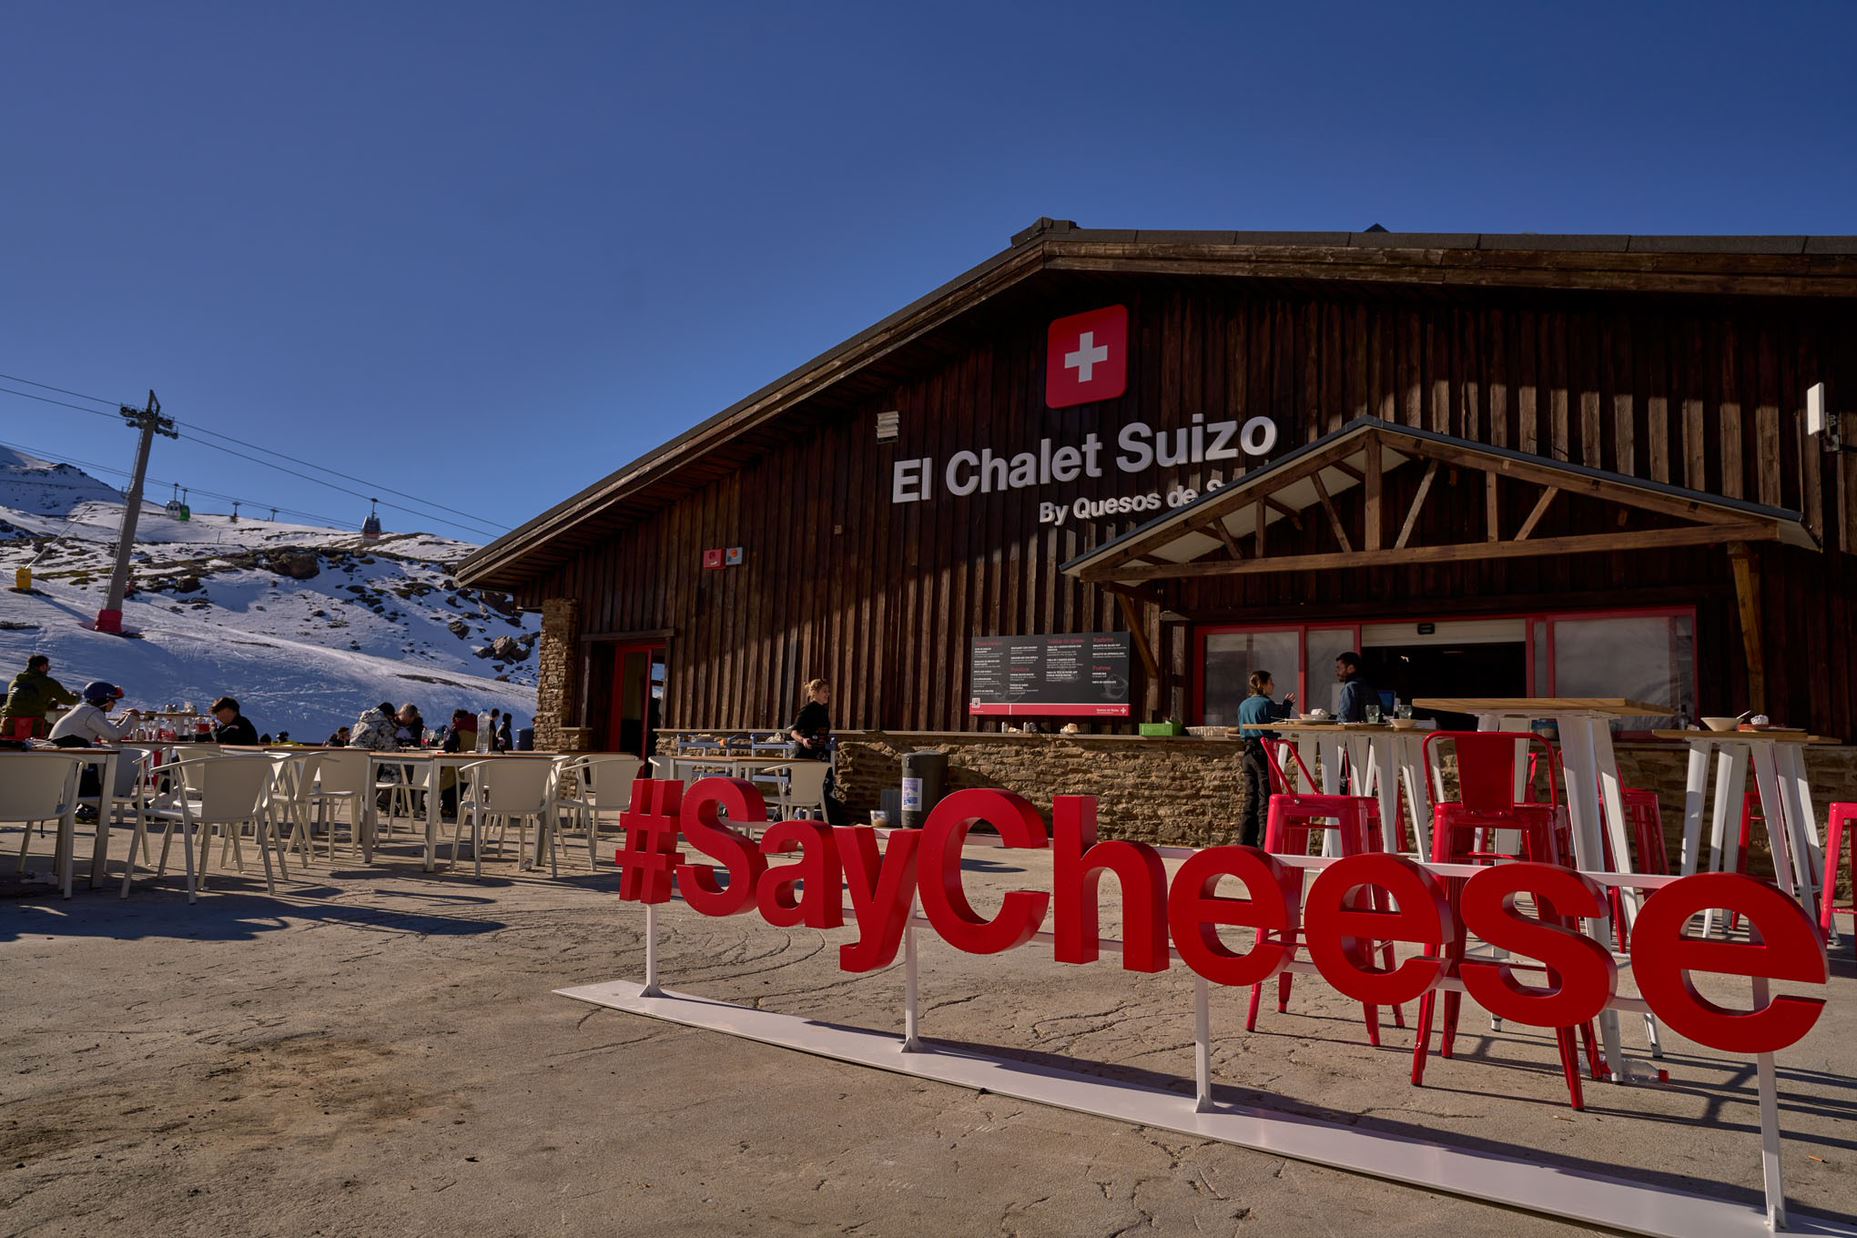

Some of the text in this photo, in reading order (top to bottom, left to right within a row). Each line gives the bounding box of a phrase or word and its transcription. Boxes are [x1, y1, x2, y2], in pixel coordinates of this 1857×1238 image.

[892, 413, 1278, 503] El Chalet Suizo
[1039, 501, 1069, 526] By
[1073, 491, 1161, 521] Quesos
[1167, 485, 1198, 508] de
[615, 776, 1829, 1053] #SayCheese
